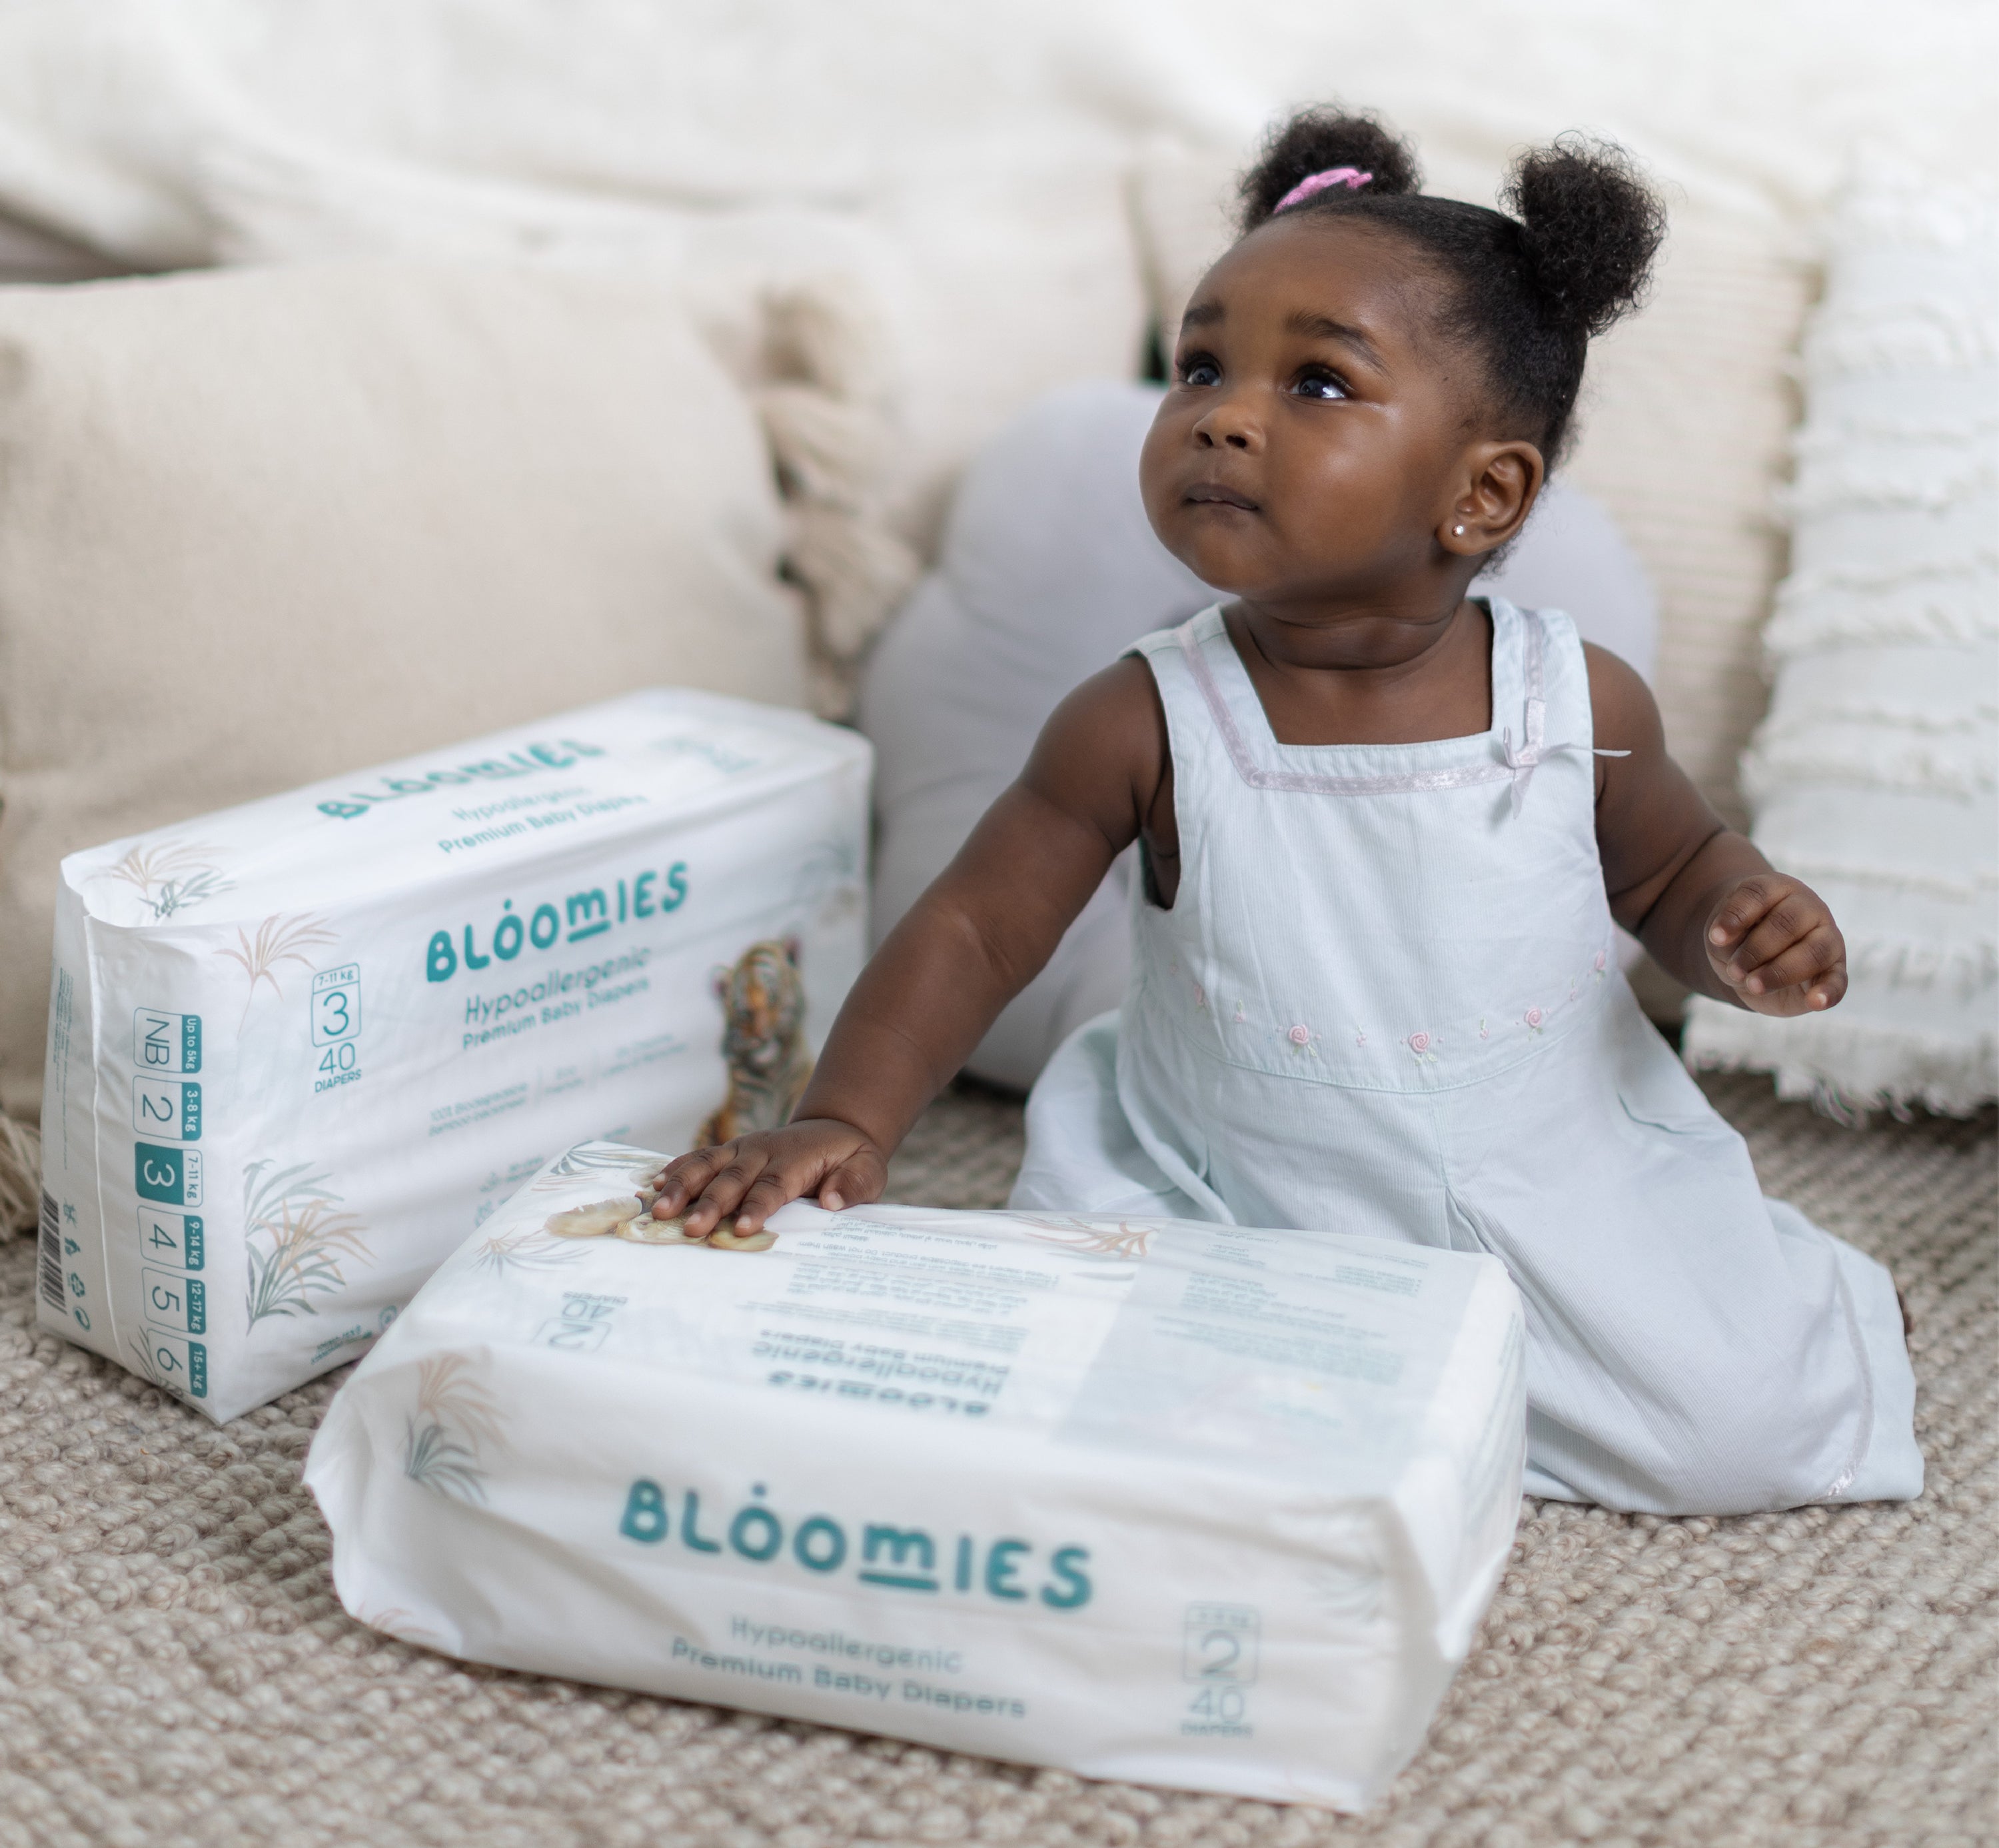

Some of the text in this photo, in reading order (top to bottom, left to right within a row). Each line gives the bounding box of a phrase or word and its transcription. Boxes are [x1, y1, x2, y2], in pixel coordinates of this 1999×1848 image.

[438, 821, 526, 853] Premium
[426, 862, 688, 982] BLOOMIES
[319, 968, 354, 986] 7-11 kg
[466, 944, 652, 1024] Hypoallergenic
[323, 991, 349, 1036] 3
[463, 977, 650, 1050] Premium Baby Diapers
[145, 1018, 170, 1065] NB
[186, 1018, 197, 1070] Up to 5kg
[319, 1042, 355, 1074] 40
[315, 1069, 361, 1093] DIAPERS
[143, 1094, 173, 1122] 2
[185, 1090, 198, 1132] 3-8 kg
[144, 1160, 176, 1187] 3
[187, 1157, 199, 1198] 7-11 kg
[149, 1224, 177, 1249] 4
[189, 1222, 201, 1265] 9-14 kg
[152, 1286, 180, 1312] 5
[191, 1283, 202, 1330] 12-17 kg
[562, 1299, 615, 1321] 40
[548, 1323, 594, 1353] 2
[157, 1348, 183, 1372] 6
[193, 1374, 203, 1389] kg
[620, 1477, 1093, 1610] BLOOMIES
[730, 1615, 962, 1674] Hypoallergenic
[1199, 1629, 1240, 1677] 2
[672, 1637, 1025, 1718] Premium Baby Diapers
[1187, 1686, 1243, 1721] 40
